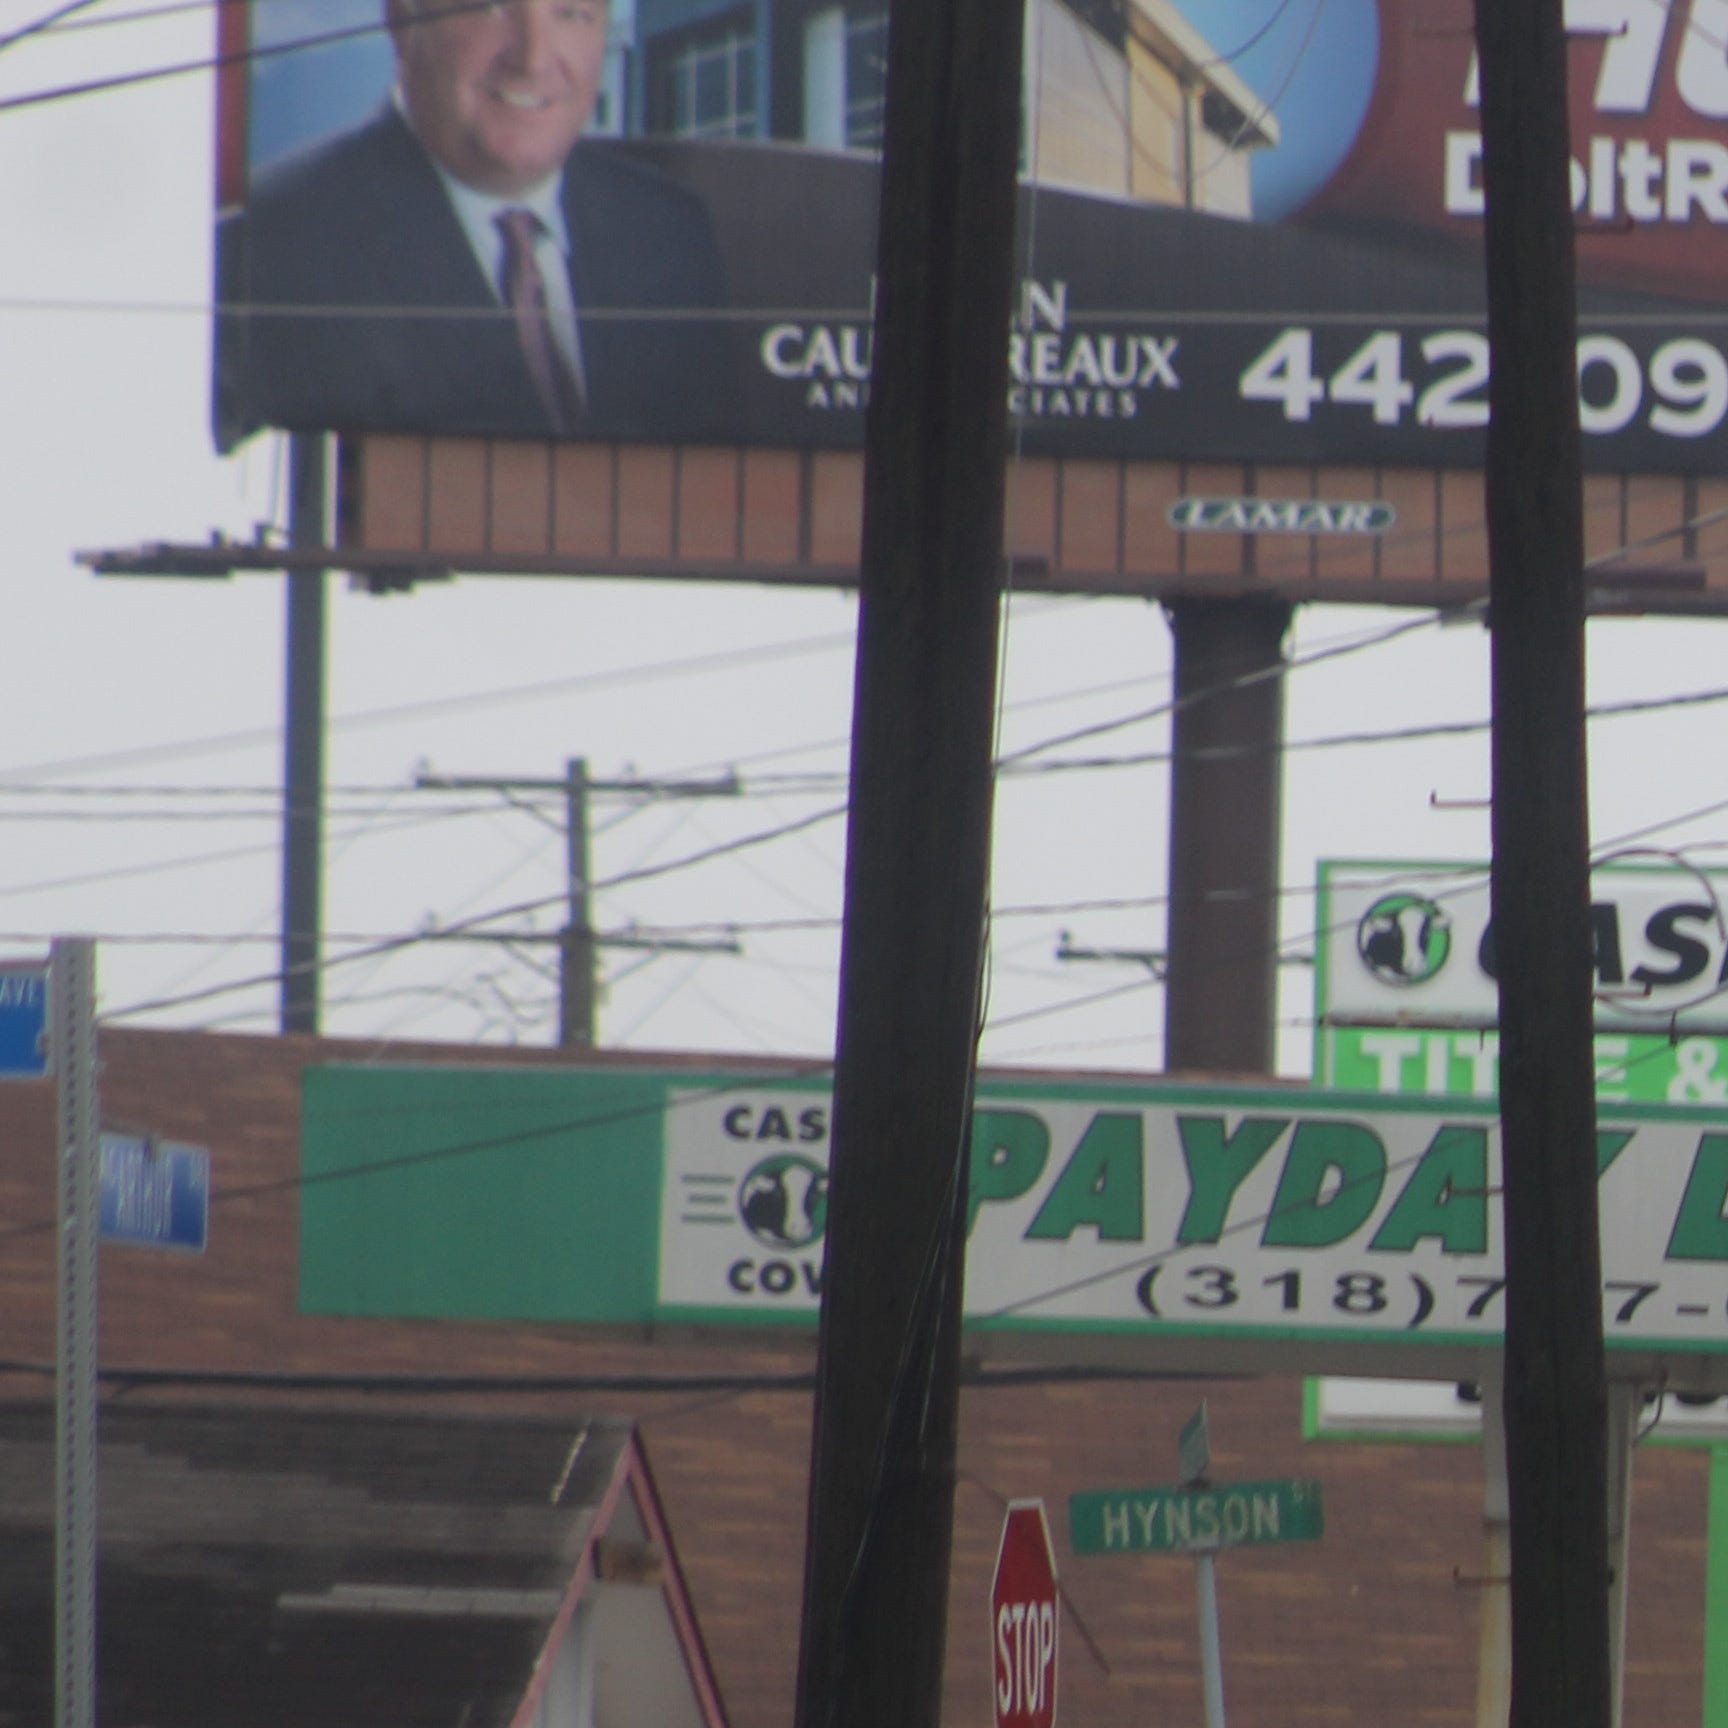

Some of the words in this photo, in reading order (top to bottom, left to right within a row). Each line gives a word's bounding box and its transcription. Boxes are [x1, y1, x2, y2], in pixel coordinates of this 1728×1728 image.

[760, 323, 1180, 389] CAUREAUX
[807, 383, 870, 408] AN
[1184, 500, 1373, 532] LAMAR
[1360, 1034, 1630, 1103] TITE
[723, 1105, 826, 1141] CAS
[966, 1106, 1637, 1254] PAYDA
[1102, 1493, 1280, 1548] HYNSON
[998, 1602, 1054, 1716] STOP
